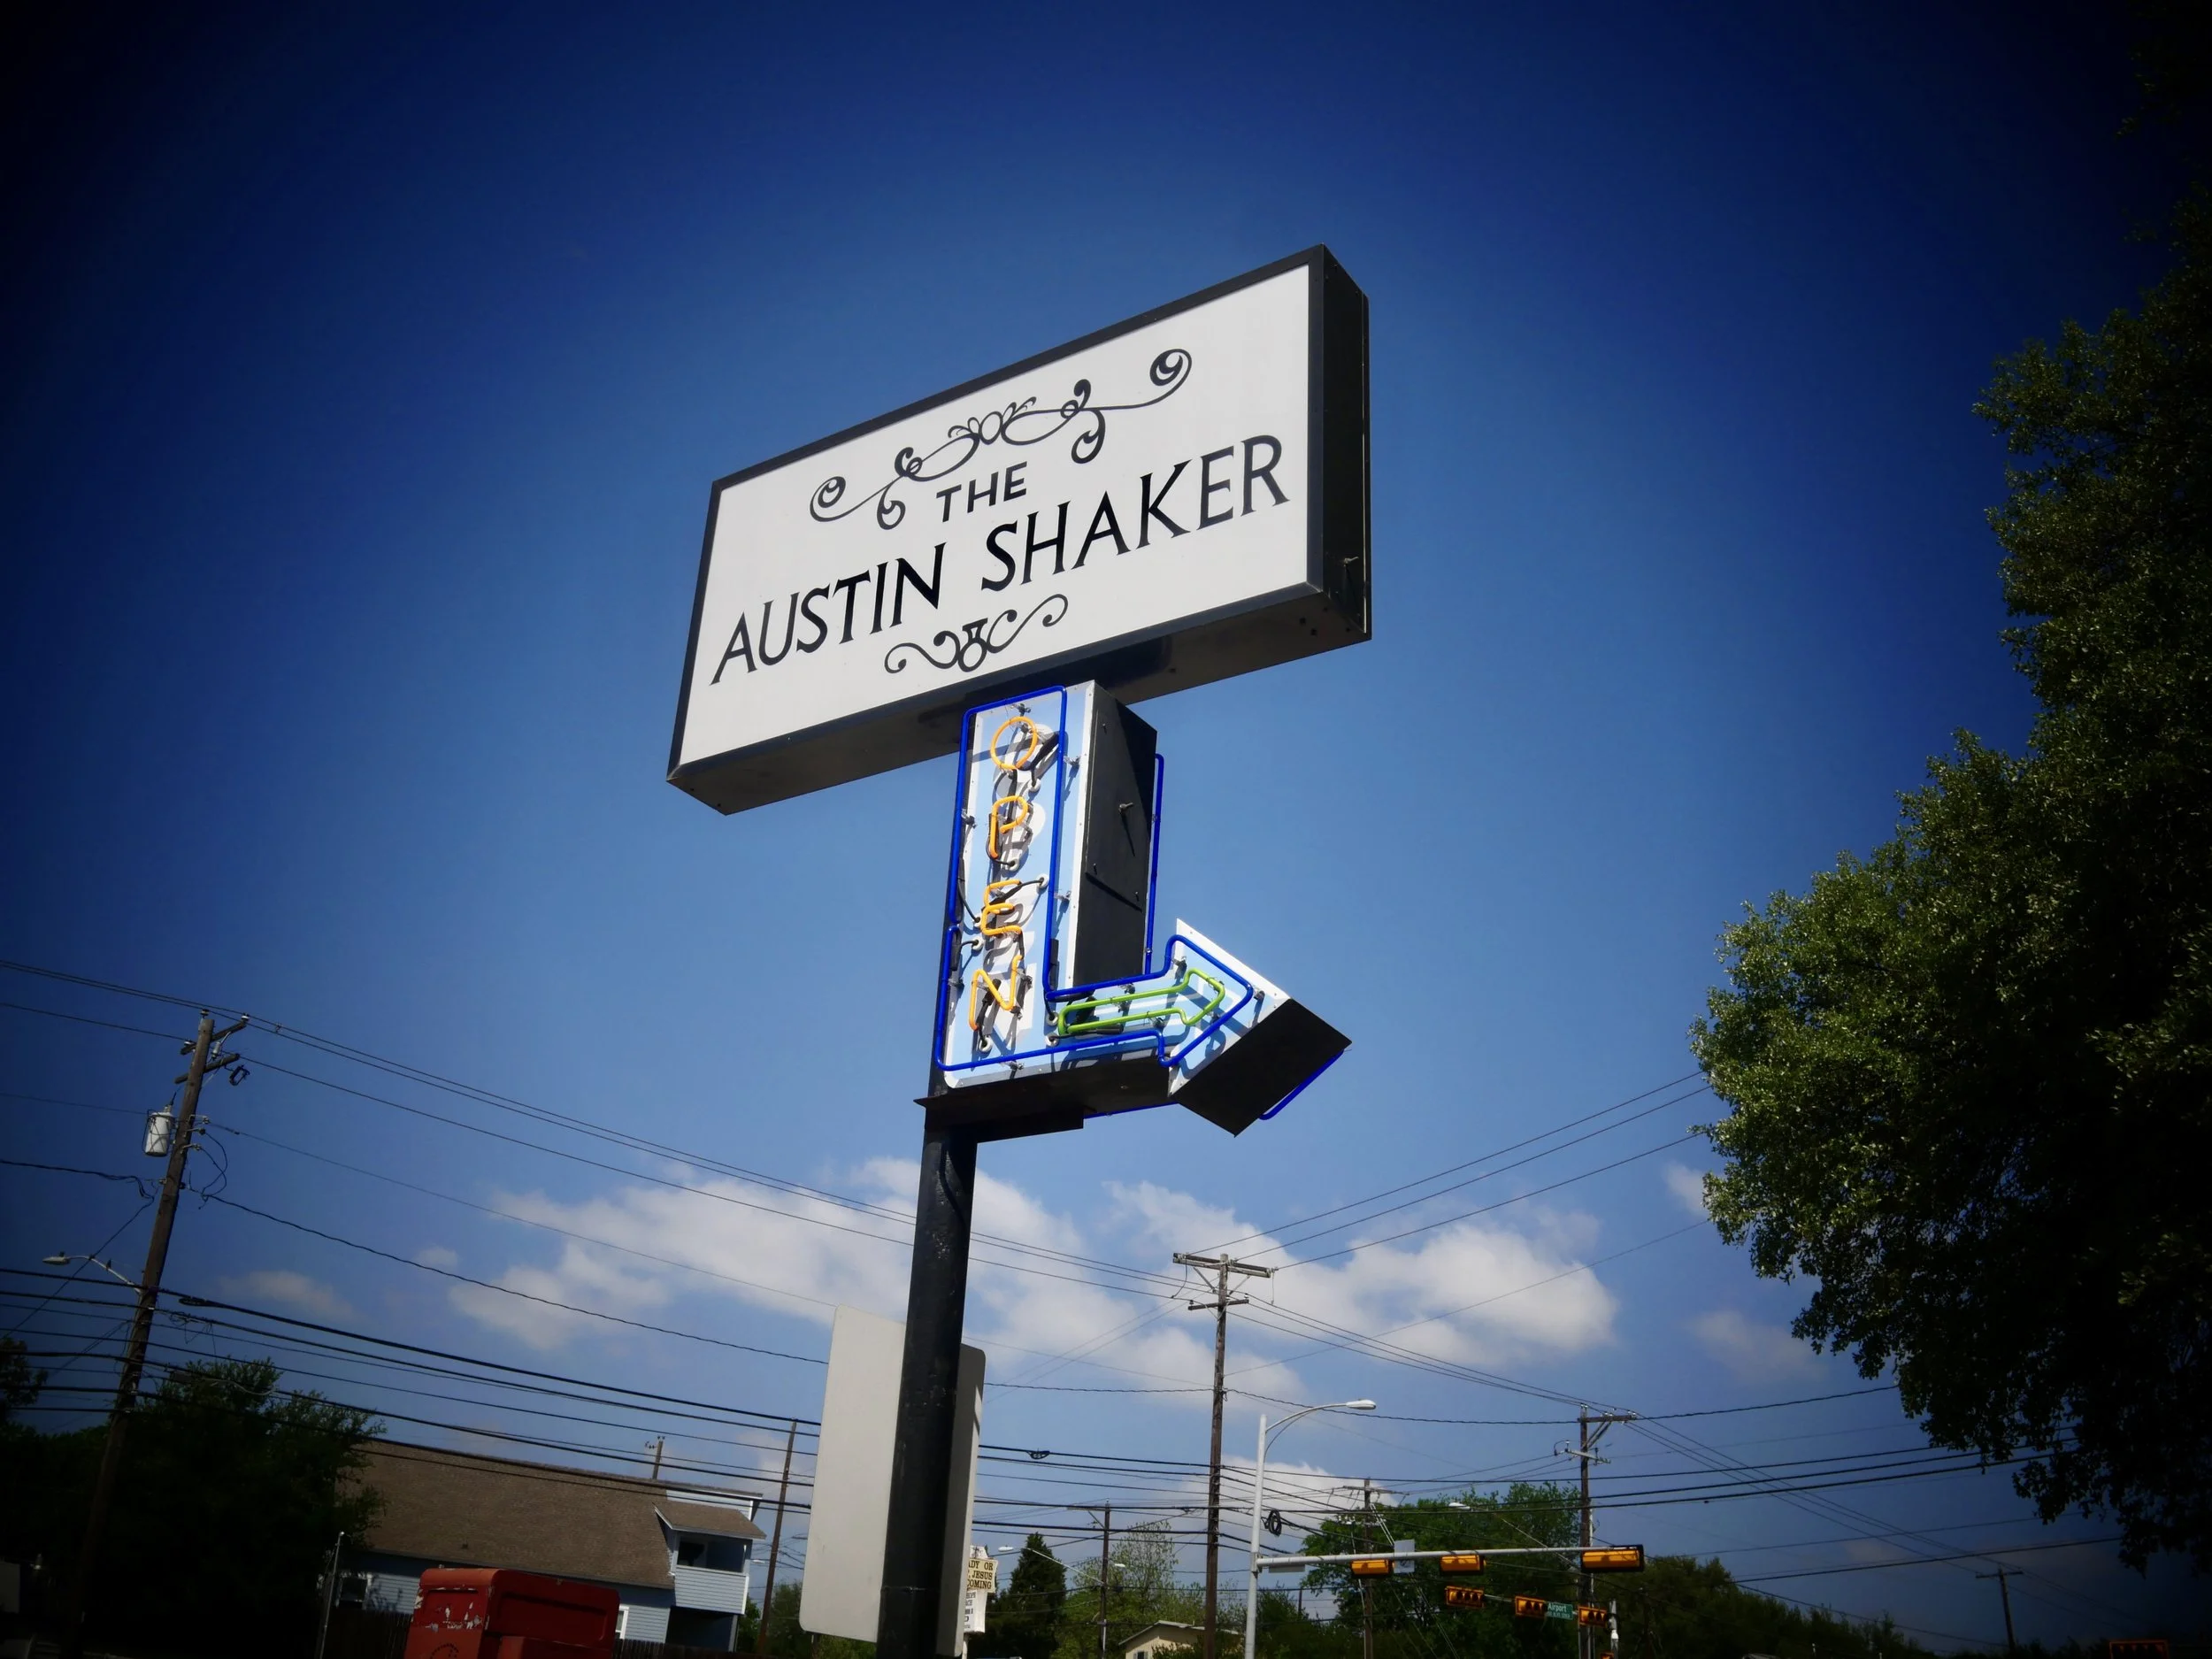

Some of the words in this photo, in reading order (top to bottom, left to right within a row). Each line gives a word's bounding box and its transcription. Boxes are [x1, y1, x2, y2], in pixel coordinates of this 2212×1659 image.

[936, 460, 1027, 523] THE
[709, 541, 948, 686] AUSTIN
[981, 434, 1289, 592] SHAKER
[968, 716, 1038, 1031] OPEN
[972, 1570, 993, 1580] JESUS
[984, 1562, 994, 1571] OR
[1548, 1602, 1567, 1613] Airport
